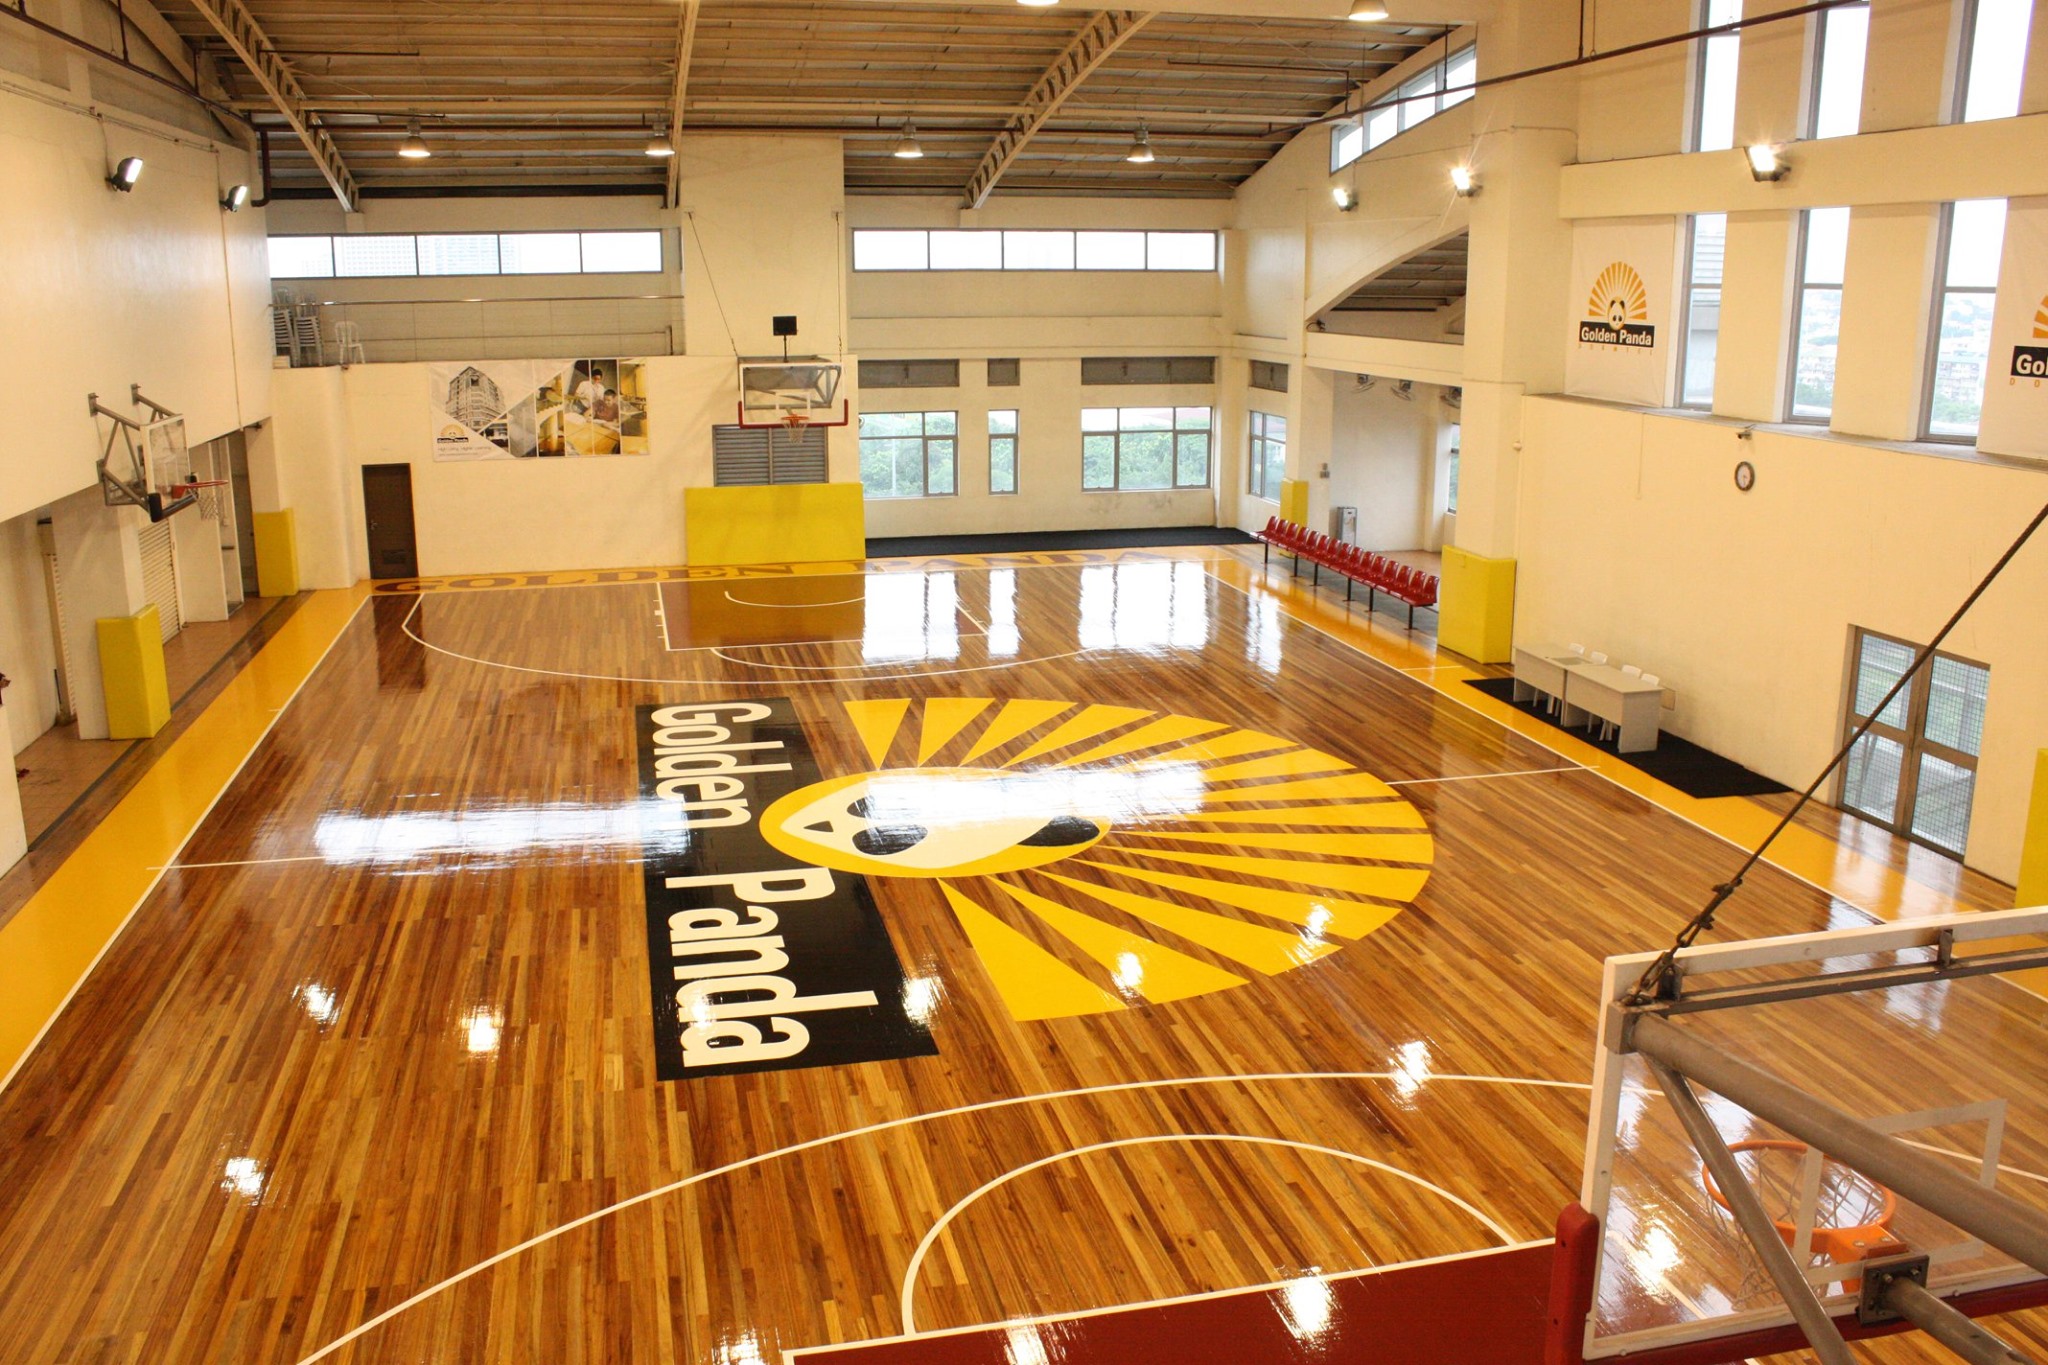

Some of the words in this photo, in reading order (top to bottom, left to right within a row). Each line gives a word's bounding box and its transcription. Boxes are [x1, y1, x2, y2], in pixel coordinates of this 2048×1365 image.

[1581, 326, 1617, 343] Golden
[1619, 329, 1652, 346] Panda
[375, 565, 794, 592] GOLDEN
[848, 550, 1177, 571] PANDA
[651, 702, 793, 831] Golden
[665, 867, 879, 1068] Panda
